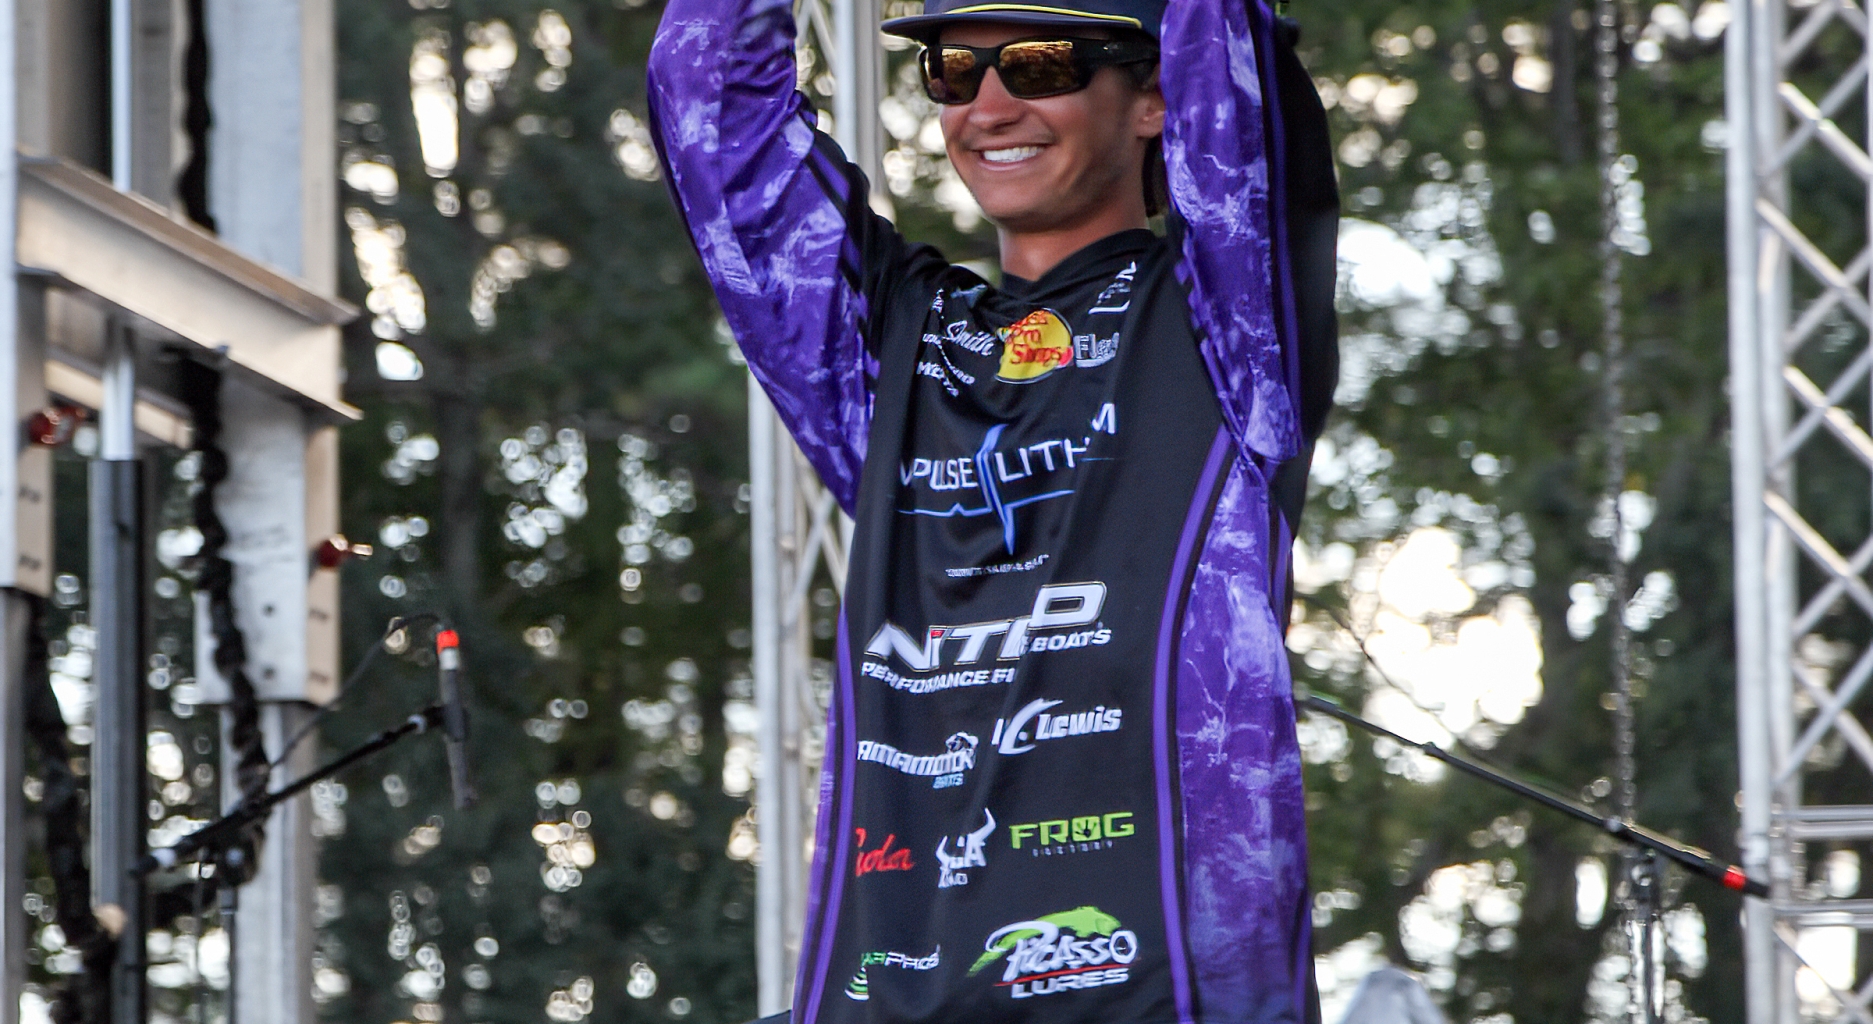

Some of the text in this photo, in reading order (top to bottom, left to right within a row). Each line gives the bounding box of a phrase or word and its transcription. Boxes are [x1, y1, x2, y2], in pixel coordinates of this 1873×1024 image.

[1028, 628, 1113, 654] BOATS
[1008, 812, 1136, 850] FROG
[1010, 967, 1130, 999] LURES
